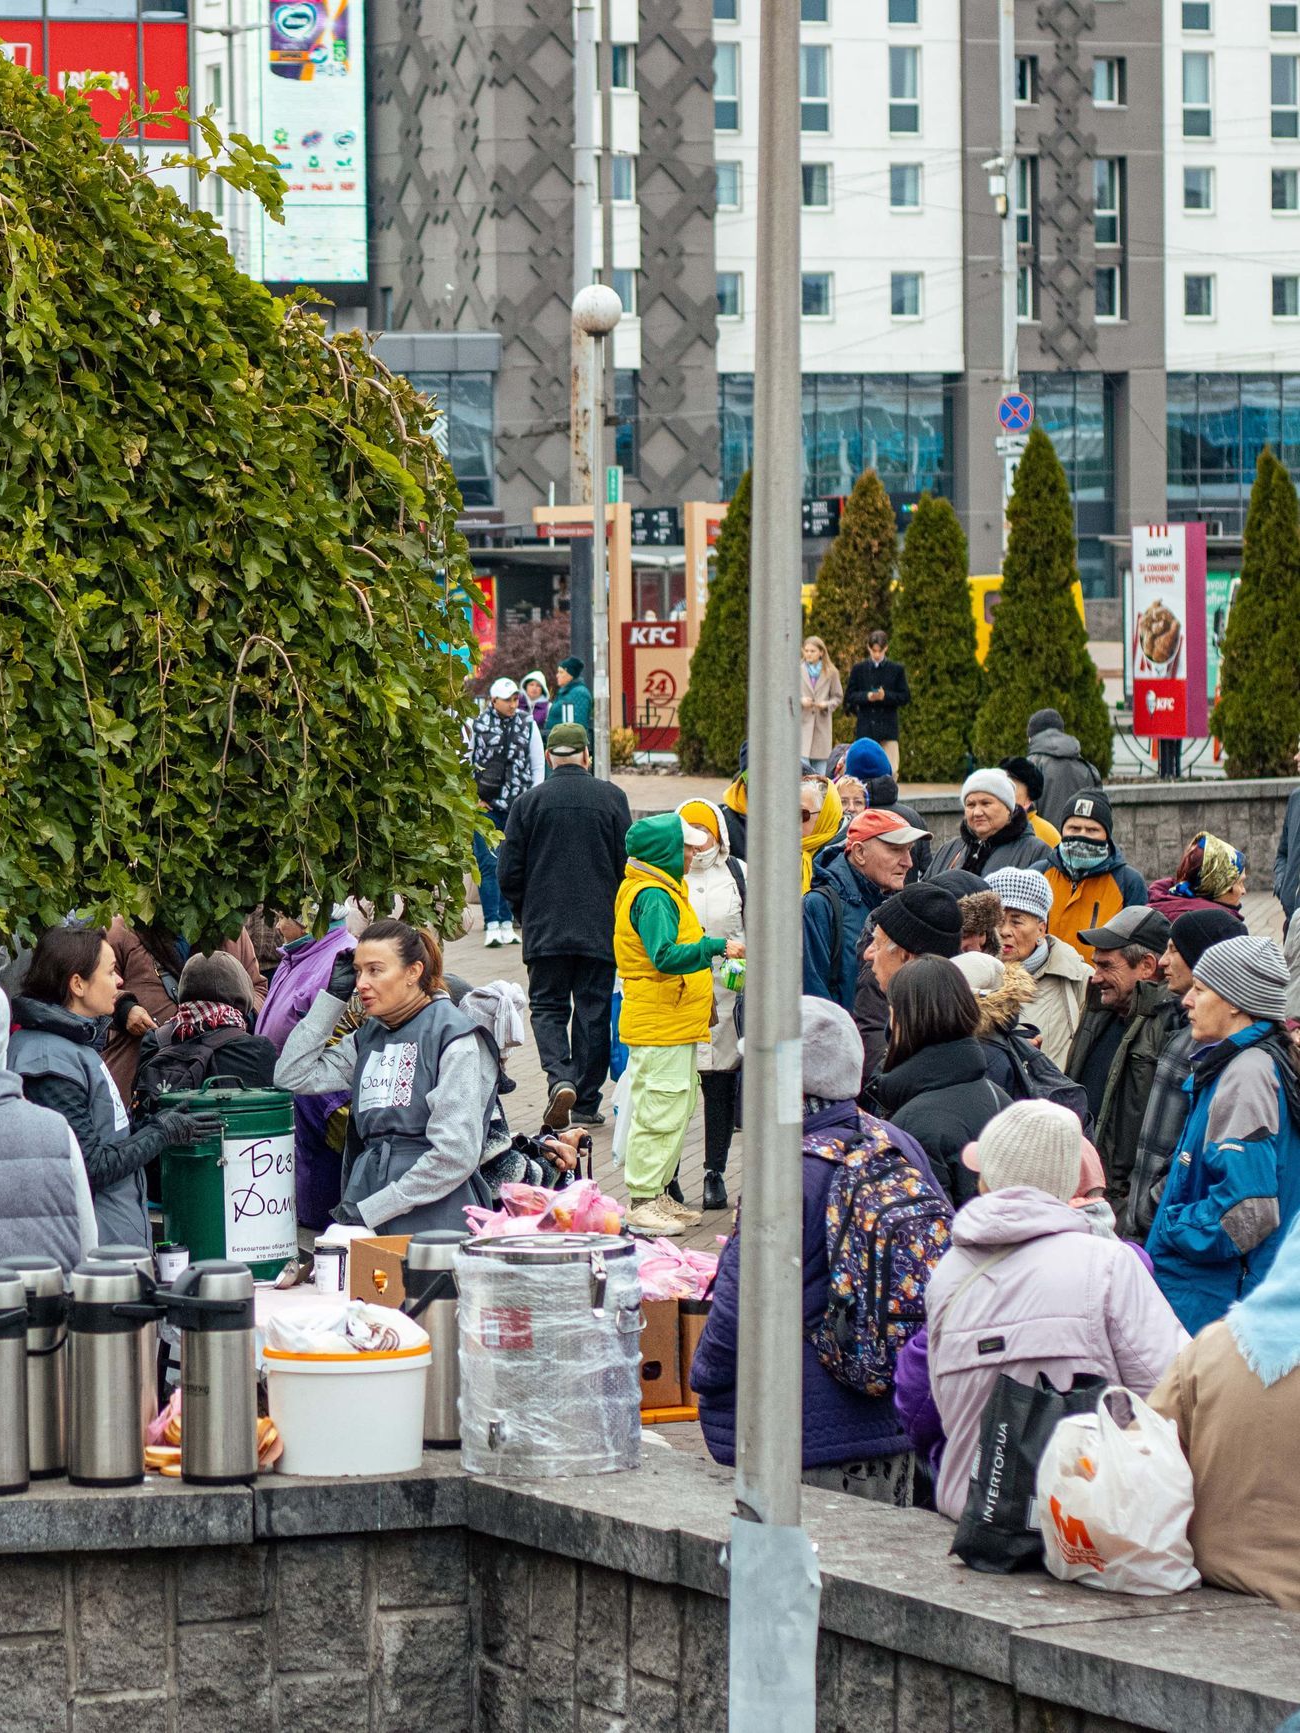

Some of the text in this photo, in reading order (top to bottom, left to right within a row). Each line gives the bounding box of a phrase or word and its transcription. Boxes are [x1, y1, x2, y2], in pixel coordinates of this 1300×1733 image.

[629, 627, 677, 646] KFC
[643, 678, 667, 694] 24
[1156, 697, 1175, 711] KFC
[239, 1139, 294, 1178] Без
[231, 1245, 270, 1253] Безкоштовні
[982, 1422, 1008, 1523] INTERTOP.UA
